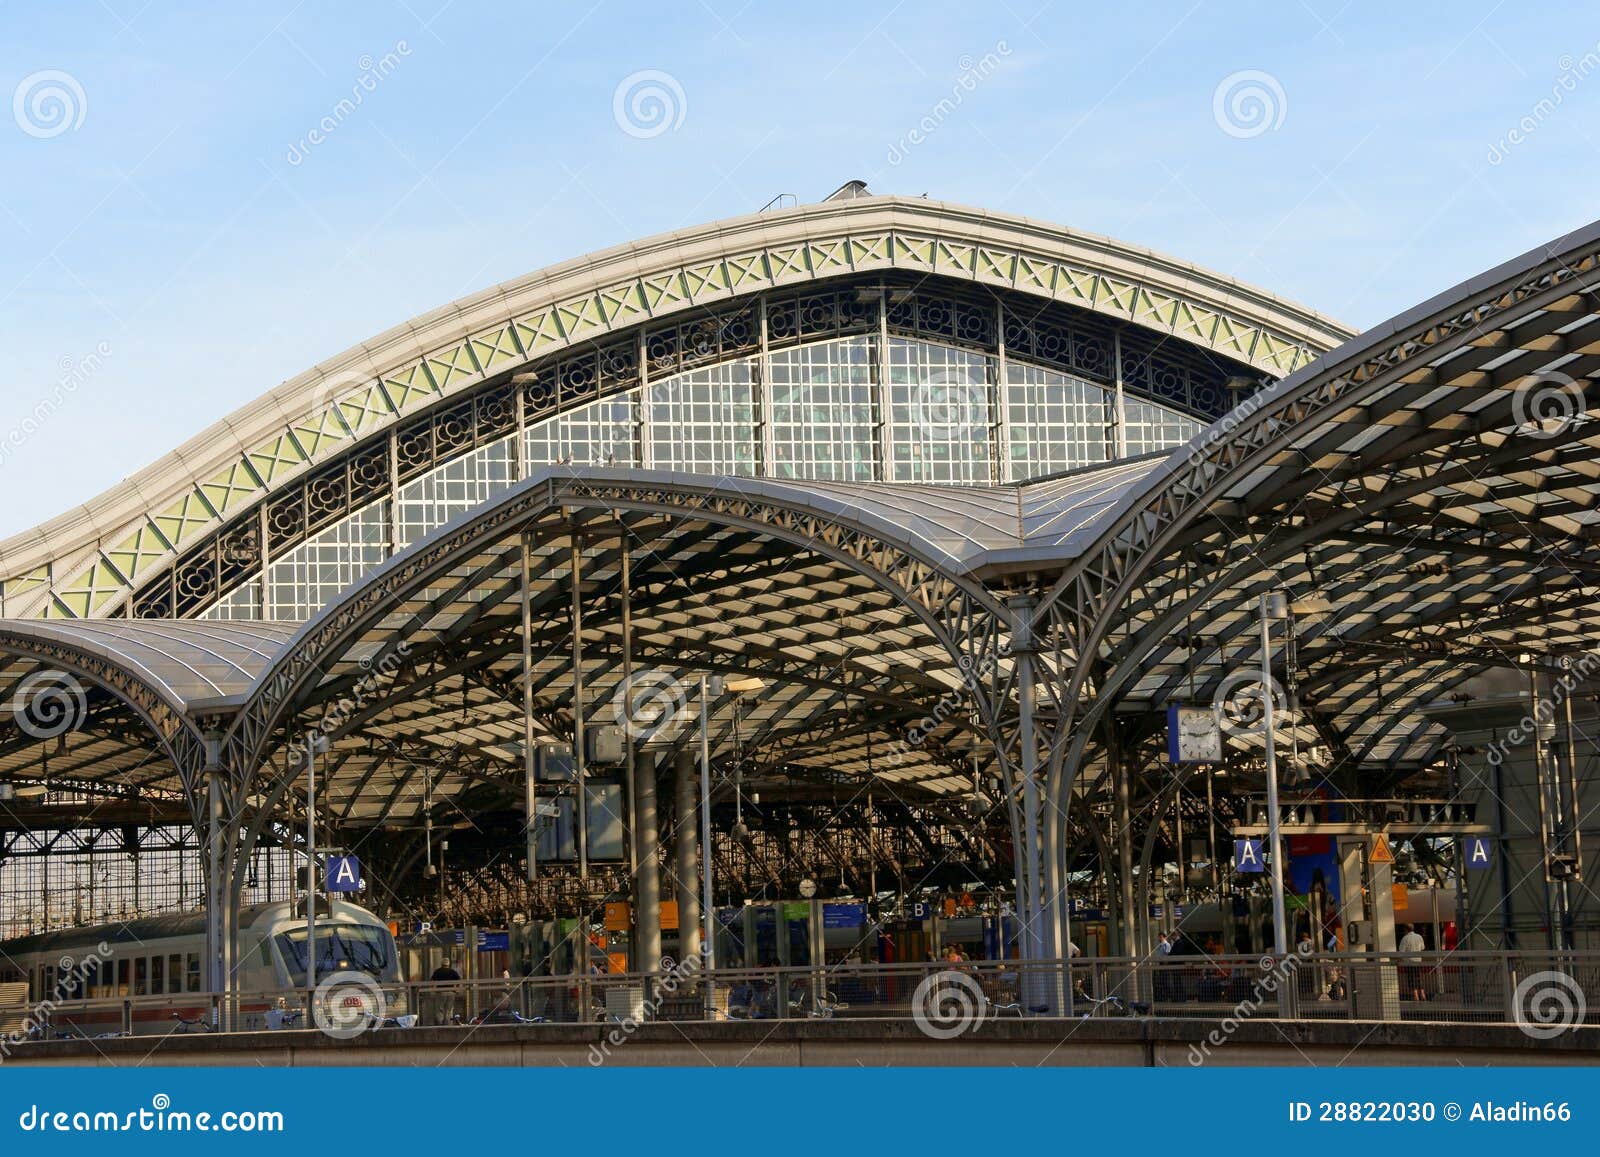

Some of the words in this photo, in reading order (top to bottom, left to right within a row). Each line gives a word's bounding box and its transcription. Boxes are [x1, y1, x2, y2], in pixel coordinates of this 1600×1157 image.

[1241, 840, 1257, 865] A
[1472, 839, 1488, 862] A
[335, 858, 355, 884] A
[914, 903, 925, 917] B
[344, 996, 362, 1007] DB
